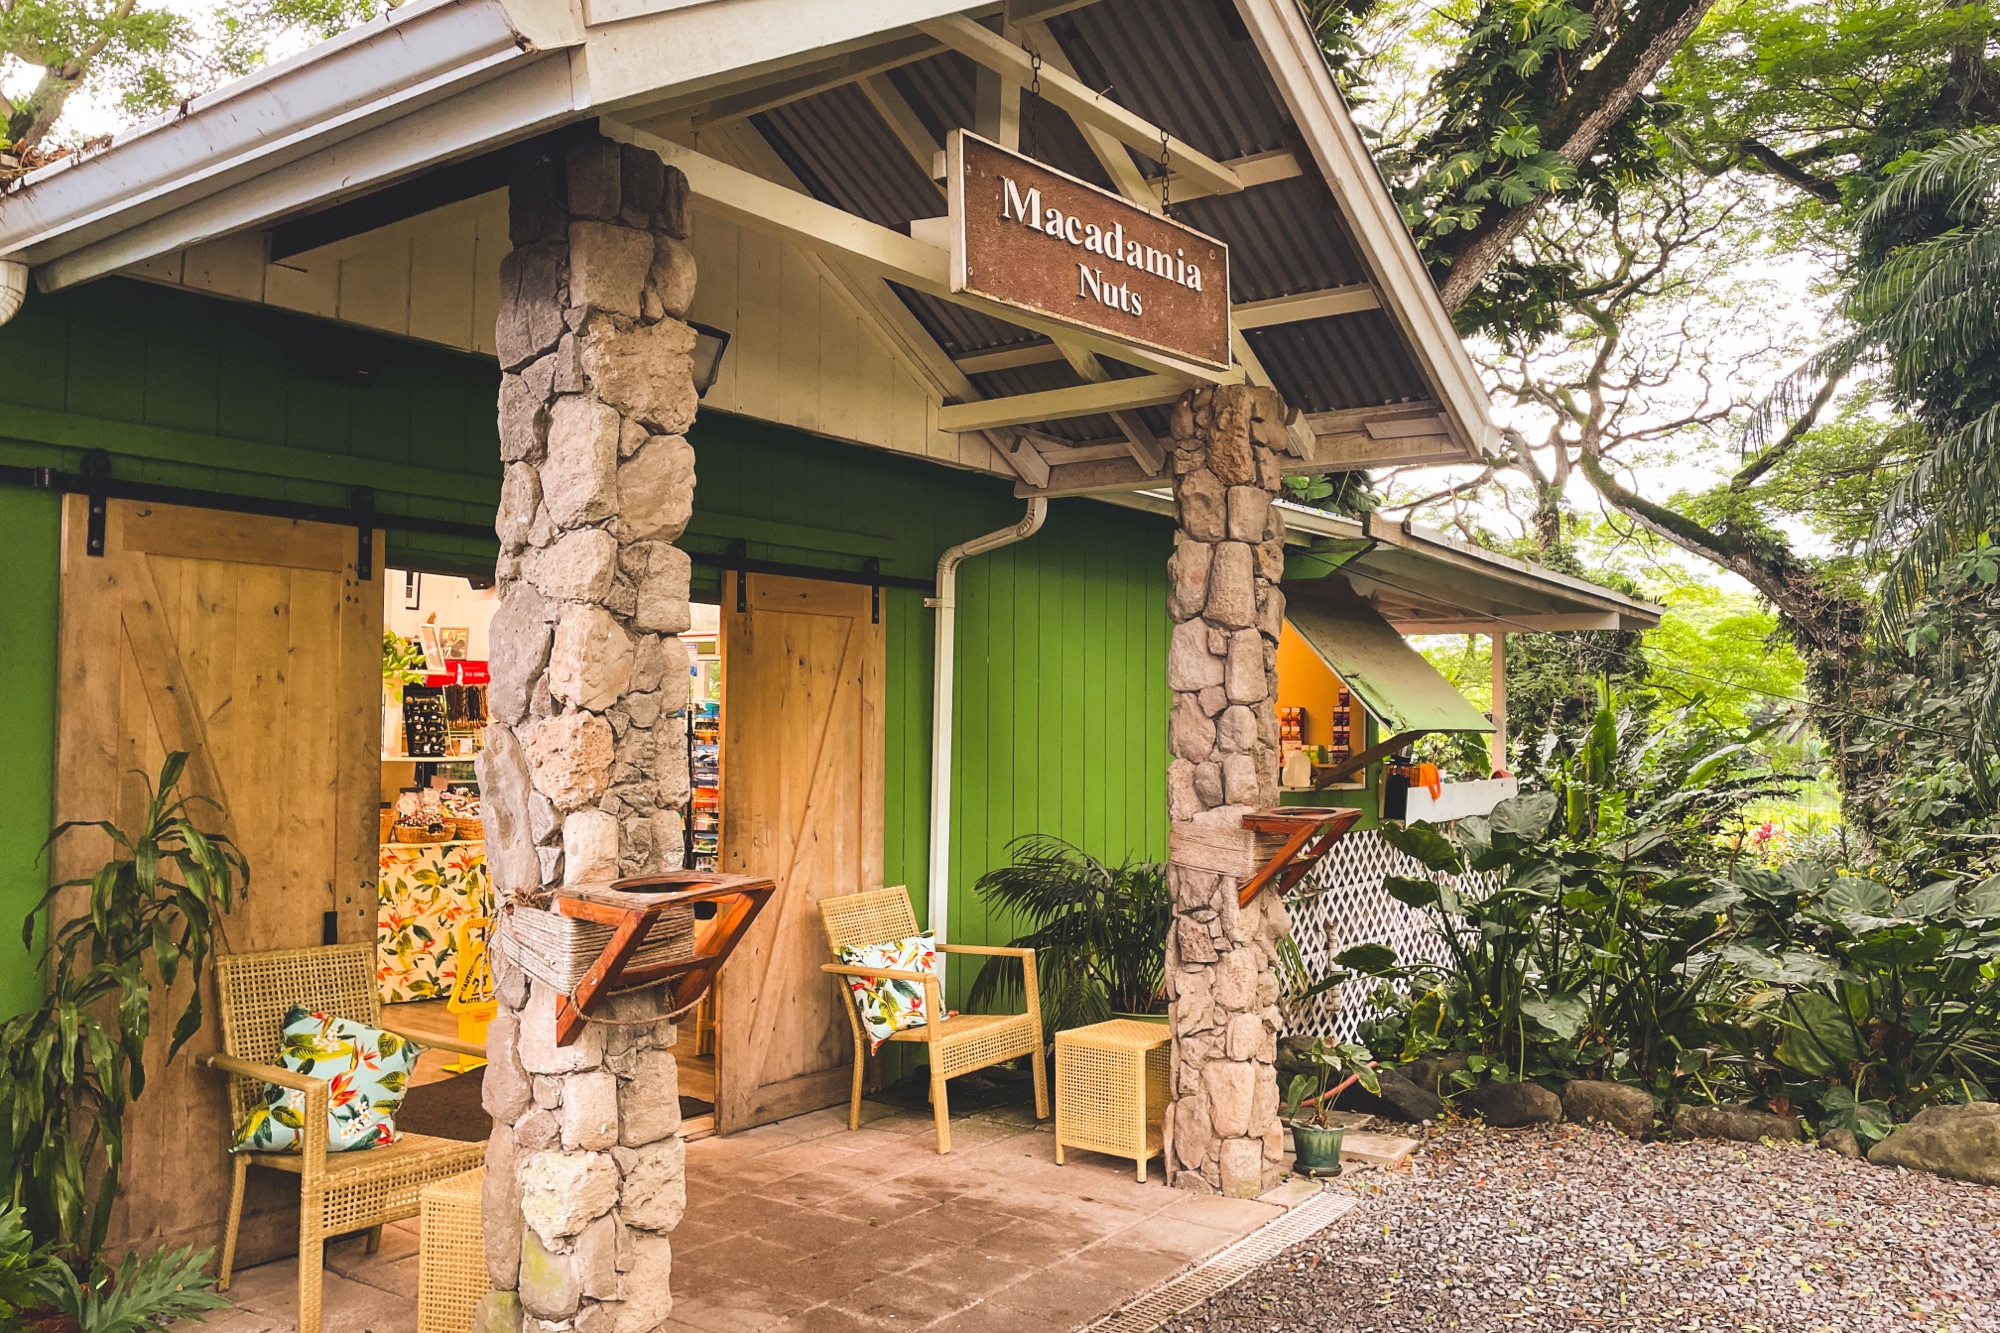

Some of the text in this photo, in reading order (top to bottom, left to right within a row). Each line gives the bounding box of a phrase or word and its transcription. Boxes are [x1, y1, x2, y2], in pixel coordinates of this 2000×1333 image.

[1001, 176, 1202, 292] Macadamia
[1078, 263, 1143, 316] Nuts
[461, 964, 475, 992] CAUTION
